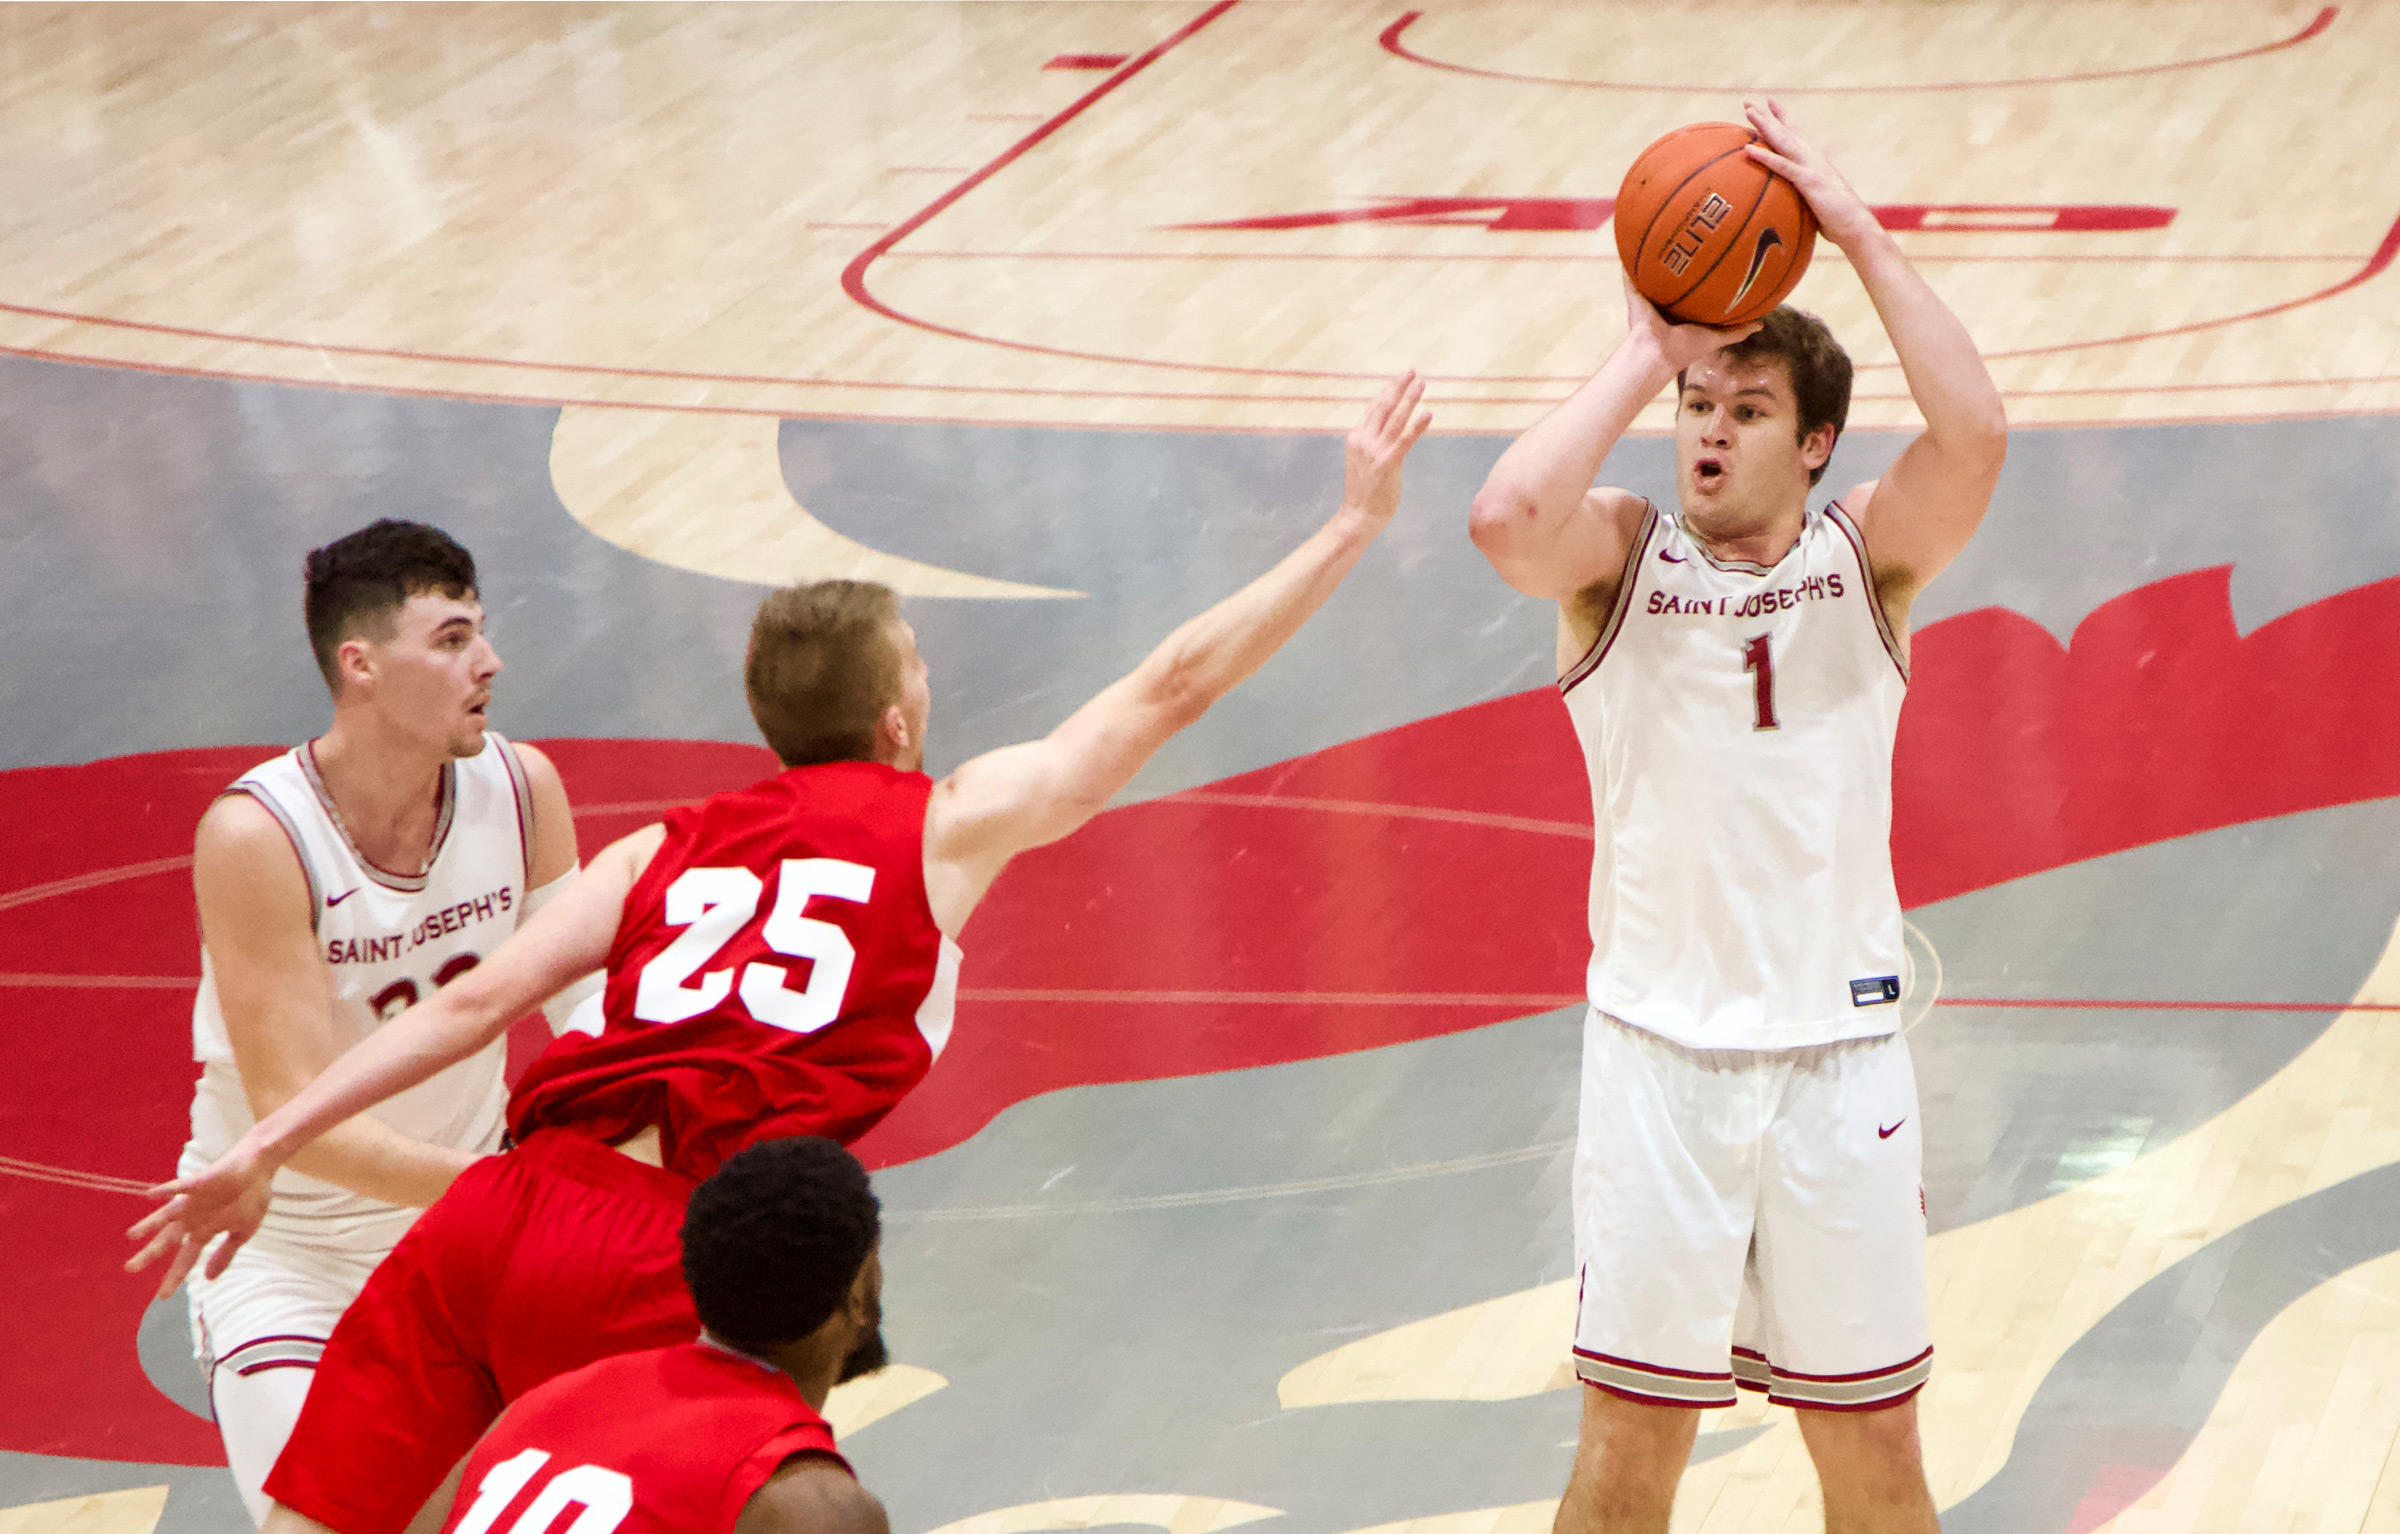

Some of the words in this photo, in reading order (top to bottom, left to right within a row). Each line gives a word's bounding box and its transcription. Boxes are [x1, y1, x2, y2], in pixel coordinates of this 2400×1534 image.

[1663, 192, 1732, 276] ELITE
[1647, 590, 1733, 615] SAINT
[1734, 574, 1844, 617] JOSEPH'S
[1740, 631, 1781, 732] 1
[326, 935, 404, 964] SAINT
[407, 886, 512, 952] OSEPH'S
[634, 858, 876, 1034] 25
[452, 1447, 634, 1534] 10
